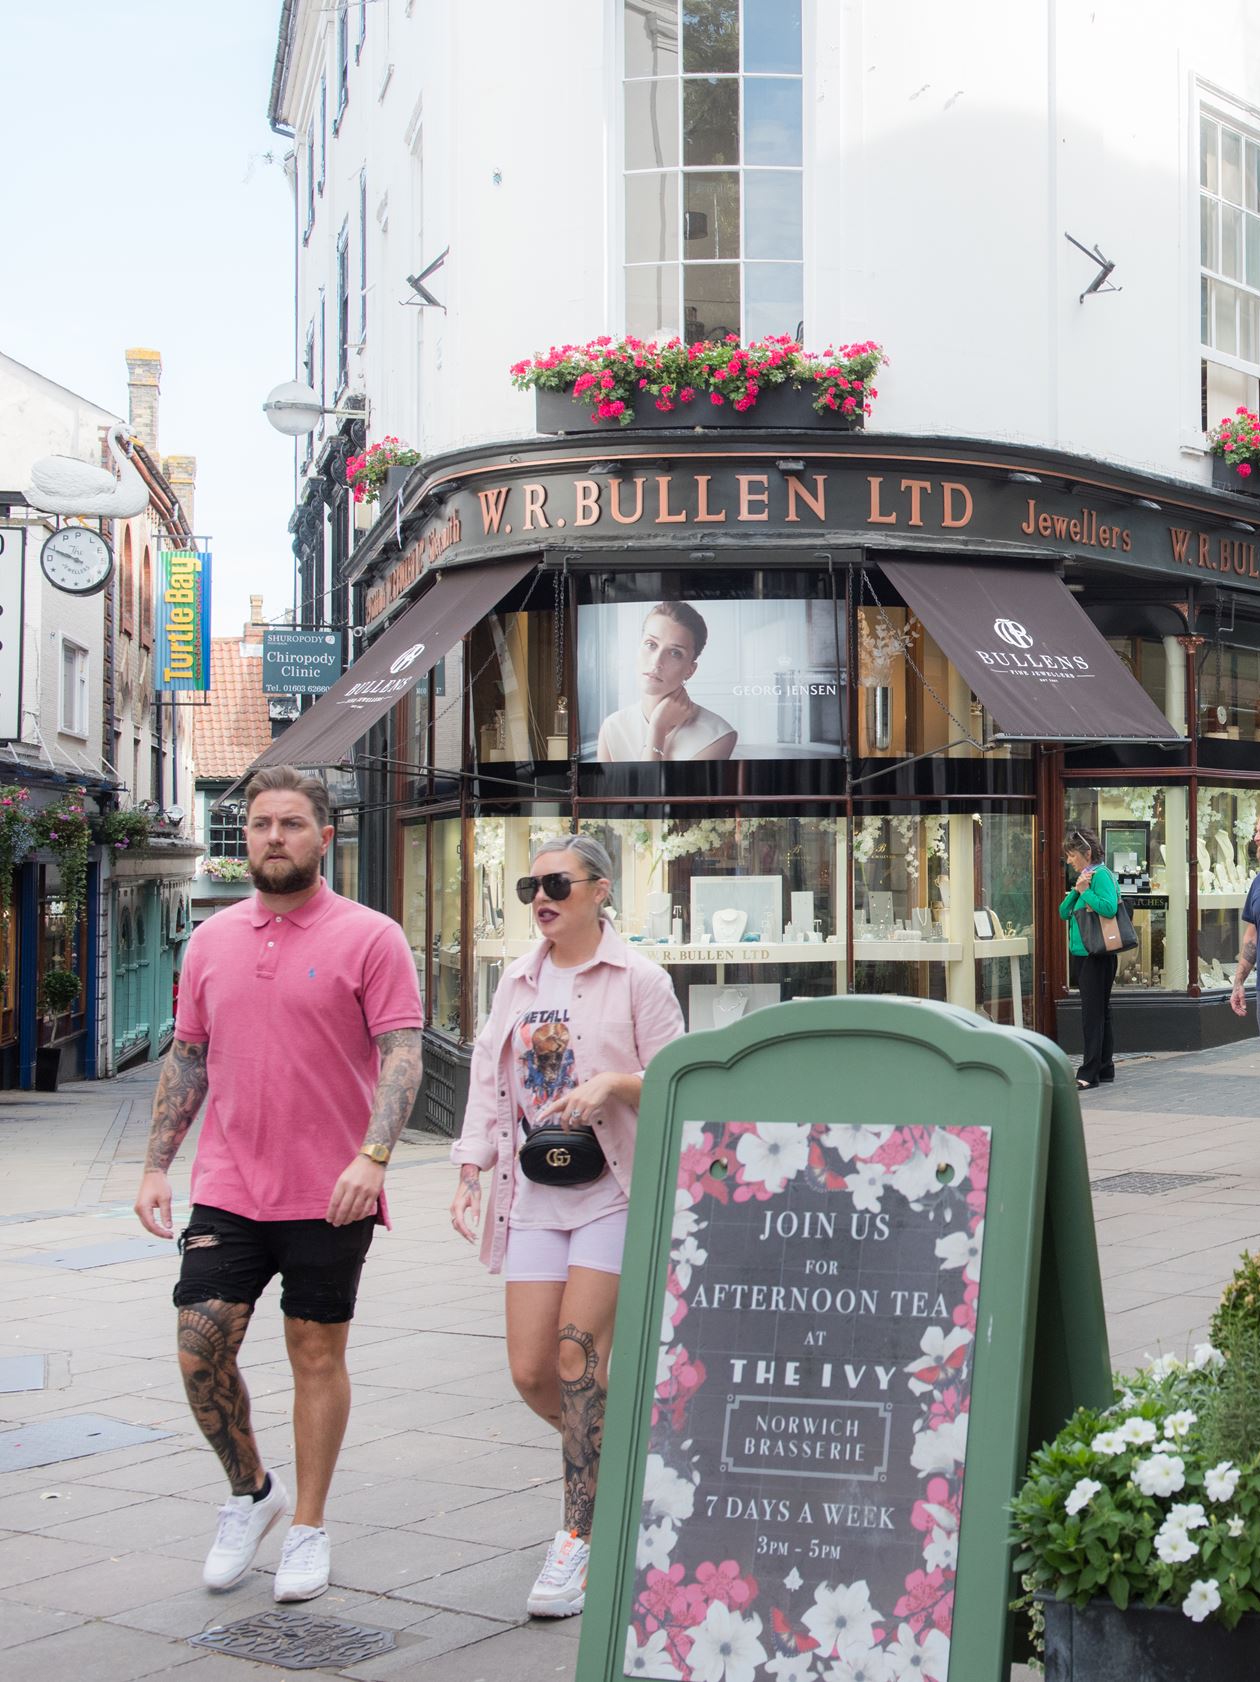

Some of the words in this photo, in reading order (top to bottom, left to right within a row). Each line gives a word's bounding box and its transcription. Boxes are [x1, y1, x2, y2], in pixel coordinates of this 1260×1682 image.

[867, 477, 974, 528] LTD
[1021, 499, 1131, 551] Jewellers
[164, 557, 201, 603] Bay
[164, 607, 194, 682] Turtle
[267, 634, 324, 643] SHUROPODY
[267, 651, 335, 665] Chiropody
[976, 650, 1089, 670] BULLENS
[281, 666, 320, 677] Clinic
[1031, 671, 1075, 679] JEWELLERS
[266, 684, 281, 692] Tel.
[283, 684, 306, 692] 01603
[308, 685, 331, 693] 62660
[344, 676, 413, 696] BULLENS
[733, 685, 781, 696] GEORG
[786, 685, 836, 696] JENSEN
[1133, 898, 1165, 906] ATCHES
[680, 950, 734, 960] BULLEN
[743, 950, 770, 960] LTD
[760, 1211, 837, 1240] JOIN
[851, 1213, 890, 1241] US
[805, 1260, 838, 1275] FOR
[690, 1284, 879, 1315] AFTERNOON
[890, 1291, 950, 1318] TEA
[804, 1331, 826, 1346] AT
[730, 1359, 800, 1386] THE
[821, 1363, 897, 1390] IVY
[756, 1415, 859, 1437] NORWICH
[744, 1437, 865, 1461] BRASSERIE
[705, 1496, 718, 1517] 7
[725, 1497, 790, 1522] DAYS
[797, 1502, 813, 1523] A
[822, 1503, 896, 1530] WEEK
[757, 1536, 789, 1556] 3PM
[808, 1539, 841, 1560] 5PM
